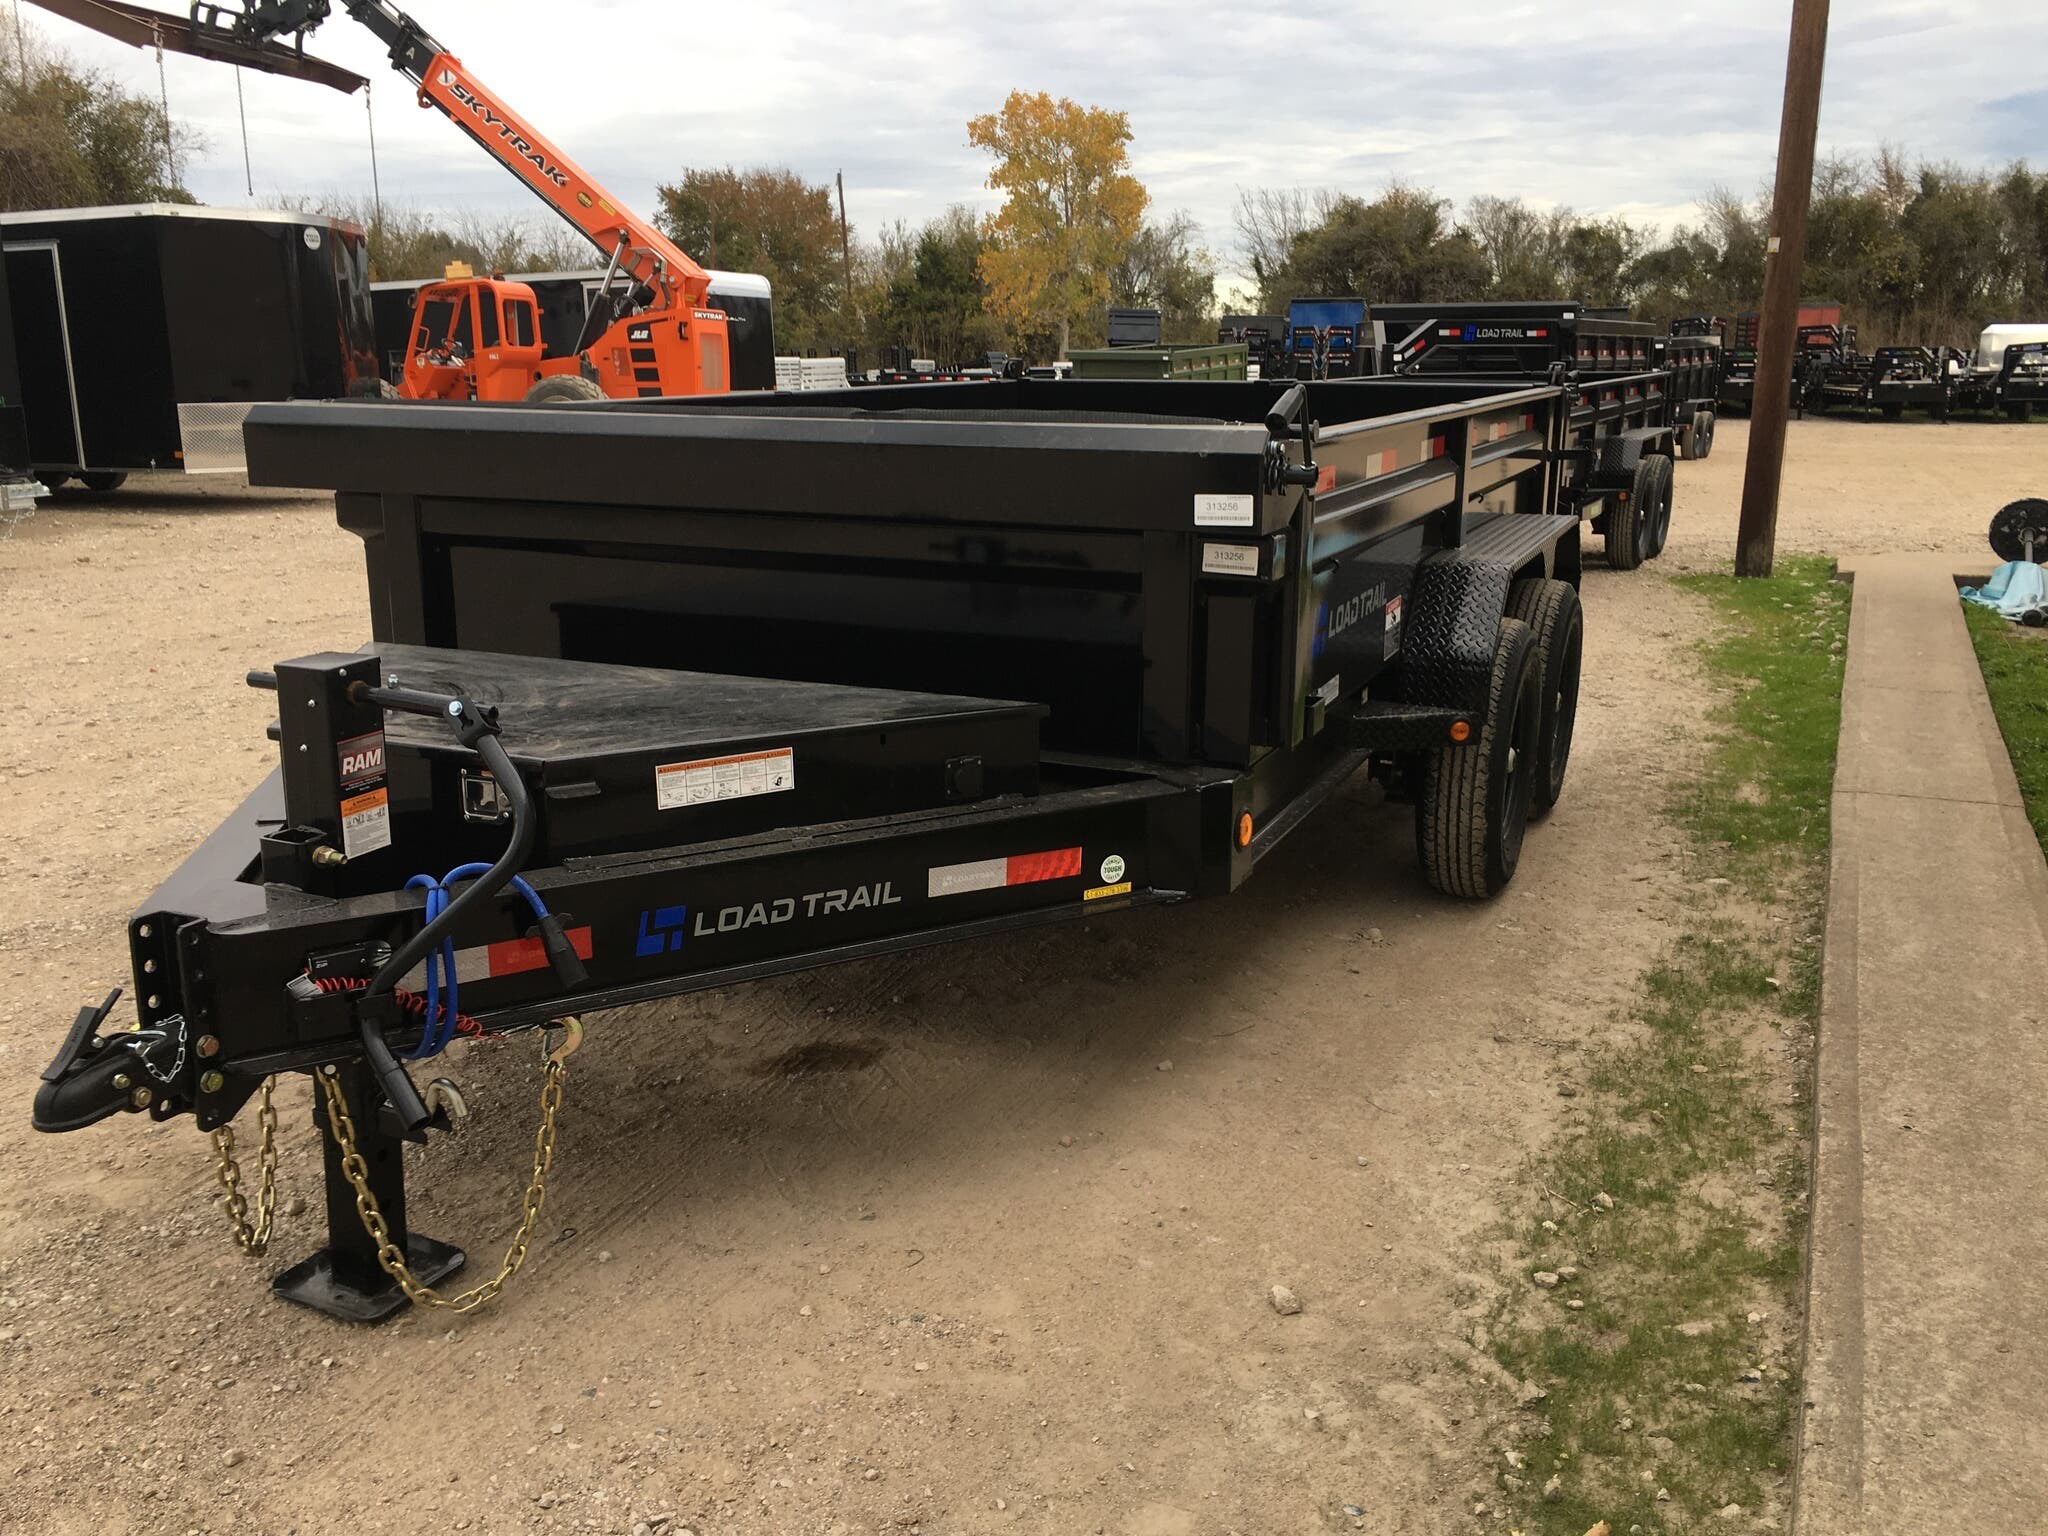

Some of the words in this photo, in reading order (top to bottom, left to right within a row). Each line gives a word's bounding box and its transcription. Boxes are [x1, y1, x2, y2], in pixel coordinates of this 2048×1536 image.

[448, 83, 569, 187] SKYTRAK
[694, 311, 723, 320] SKYTRAK
[630, 330, 649, 339] JLG
[1476, 329, 1499, 338] LOAD
[1500, 329, 1524, 338] TRAIL
[1206, 502, 1239, 511] 313256
[1214, 551, 1245, 561] 313256
[1328, 596, 1359, 638] LOAD
[1360, 580, 1387, 619] TRAIL
[342, 748, 382, 775] RAM
[1103, 865, 1122, 874] TOUGH
[693, 898, 795, 937] LOAD
[802, 881, 902, 918] TRAIL
